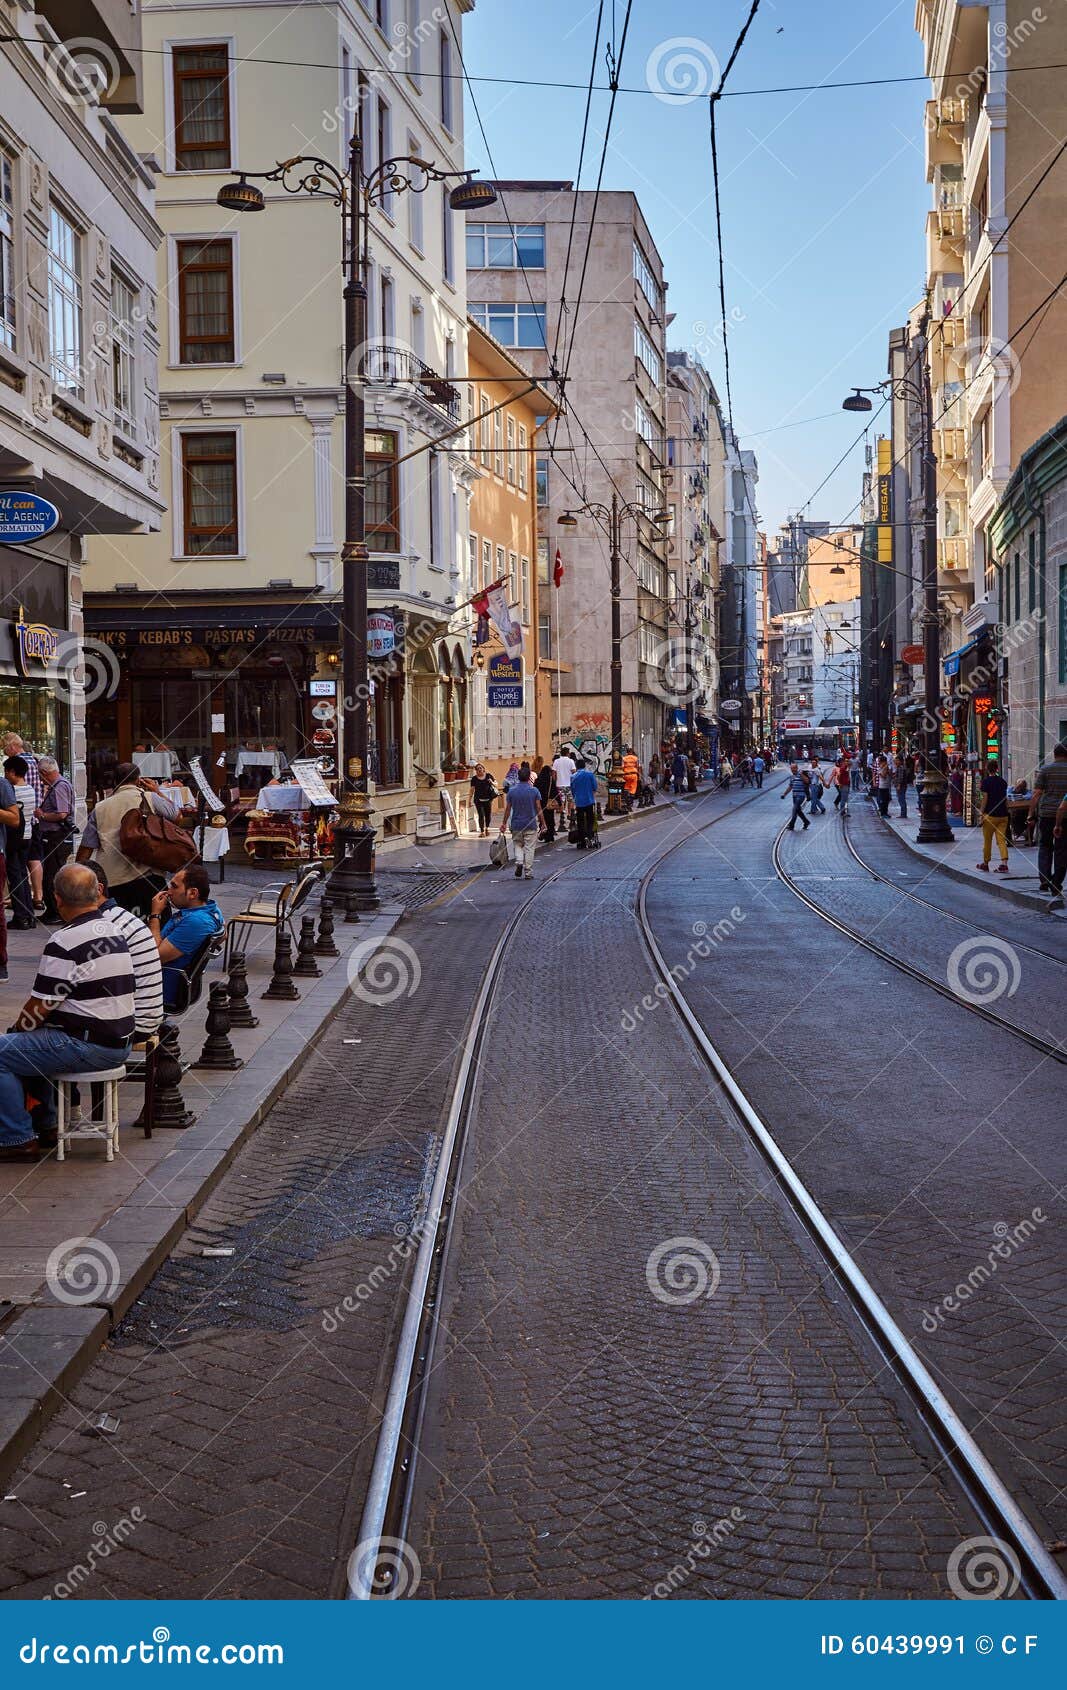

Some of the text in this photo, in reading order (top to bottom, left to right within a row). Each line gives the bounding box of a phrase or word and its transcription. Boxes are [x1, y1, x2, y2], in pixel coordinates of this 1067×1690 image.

[880, 481, 889, 522] REGAL
[14, 511, 51, 521] AGENCY
[139, 630, 192, 644] KEBAB'S
[205, 629, 255, 643] PASTA'S
[268, 628, 315, 642] PIZZA'S
[497, 663, 513, 671] Best
[491, 670, 520, 678] Western
[493, 692, 519, 700] EMPIRE
